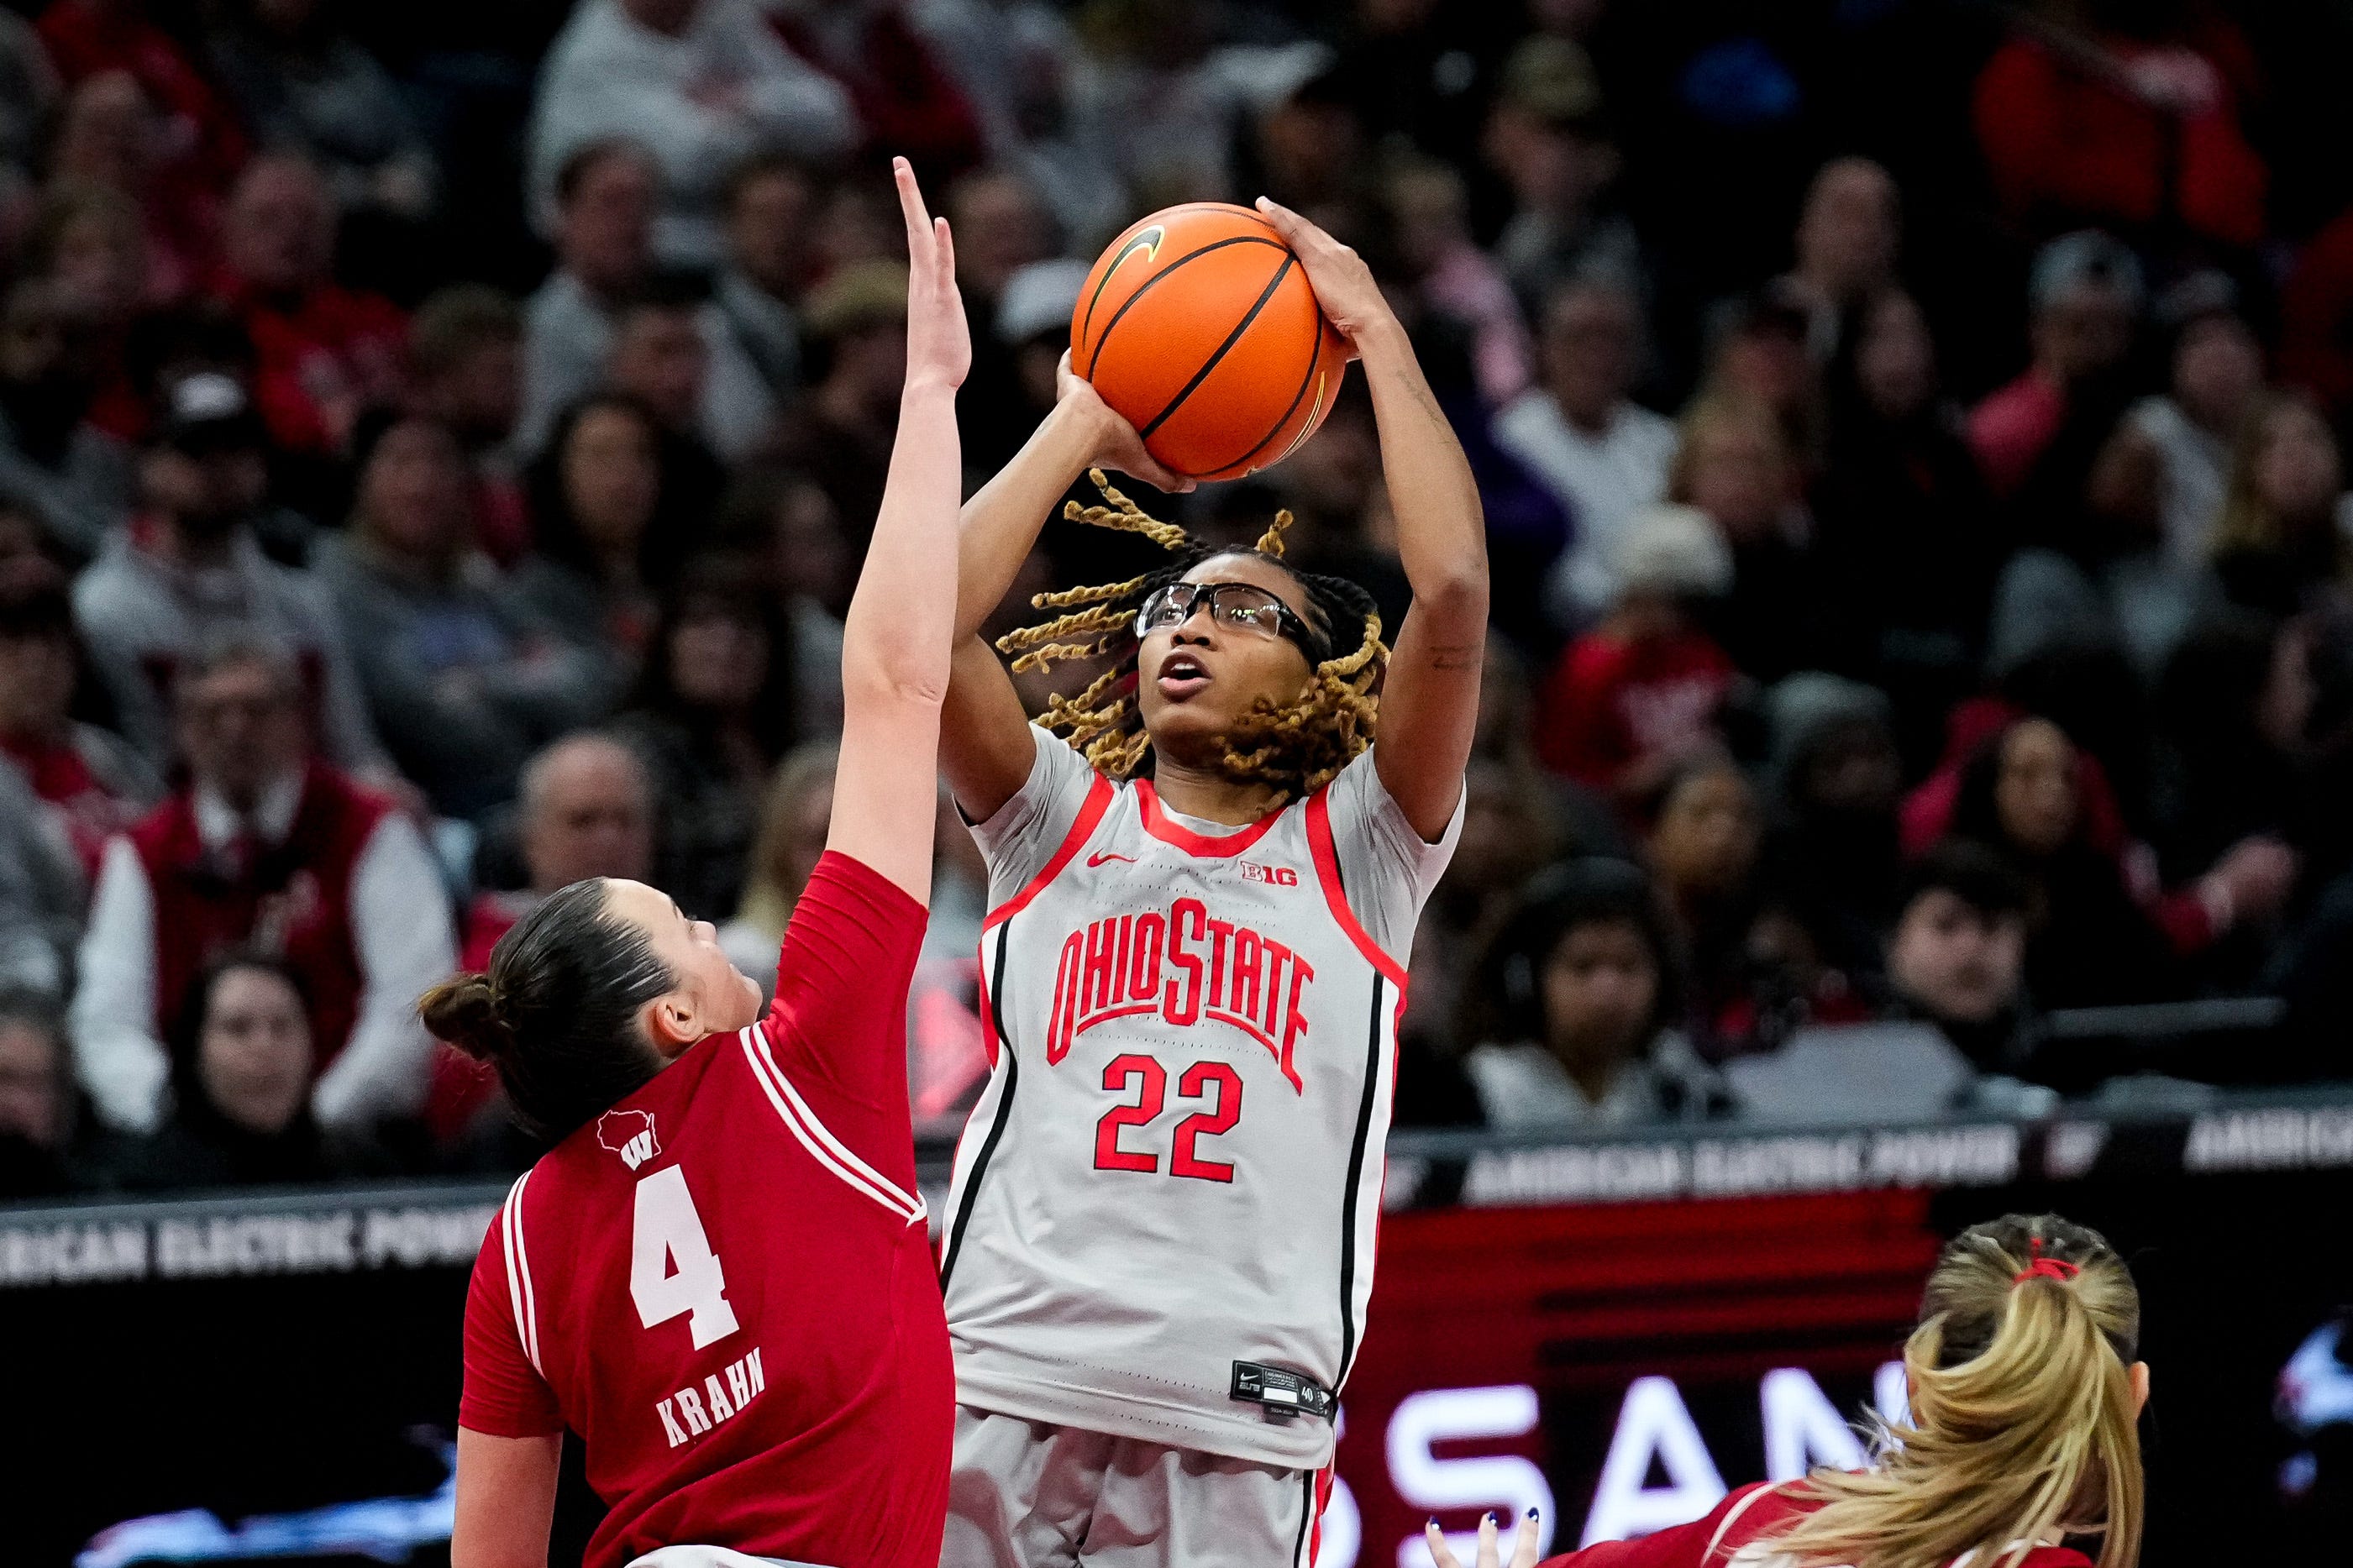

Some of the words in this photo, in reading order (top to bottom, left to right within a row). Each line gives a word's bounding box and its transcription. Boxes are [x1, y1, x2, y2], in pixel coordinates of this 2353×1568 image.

[1046, 912, 1166, 1067] OHIO
[1162, 896, 1316, 1098] STATE
[620, 1129, 654, 1172] W
[1093, 1052, 1244, 1185] 22
[629, 1163, 740, 1351] 4
[655, 1346, 766, 1449] KRAHN
